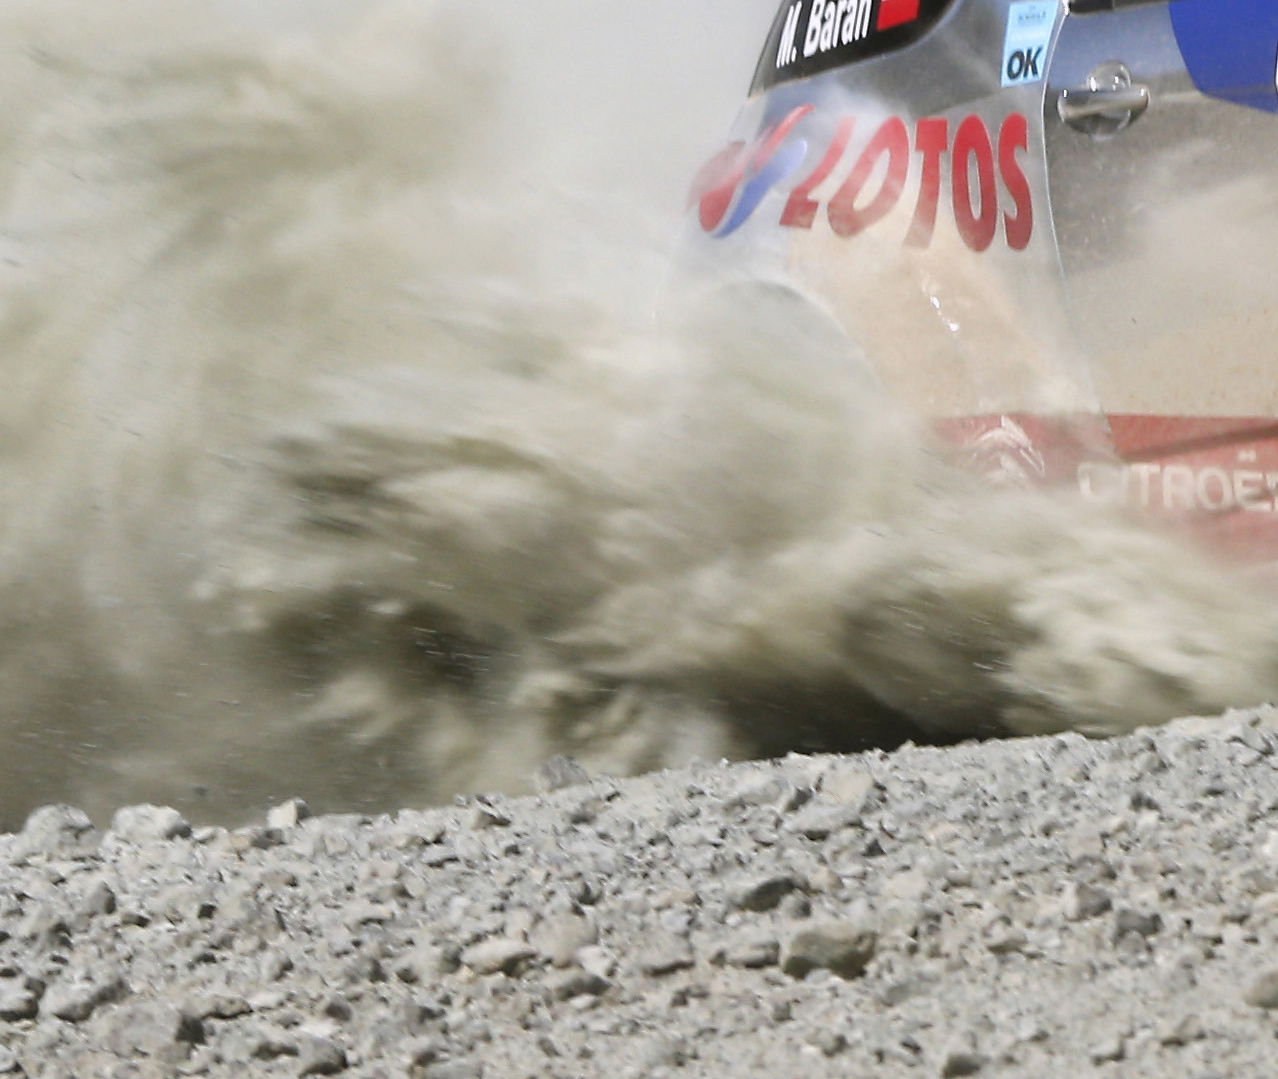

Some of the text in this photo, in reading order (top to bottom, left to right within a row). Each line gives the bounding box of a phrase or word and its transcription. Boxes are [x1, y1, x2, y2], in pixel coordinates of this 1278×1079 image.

[776, 0, 803, 70] M.
[1007, 46, 1043, 80] OK
[779, 111, 1034, 253] LOTOS
